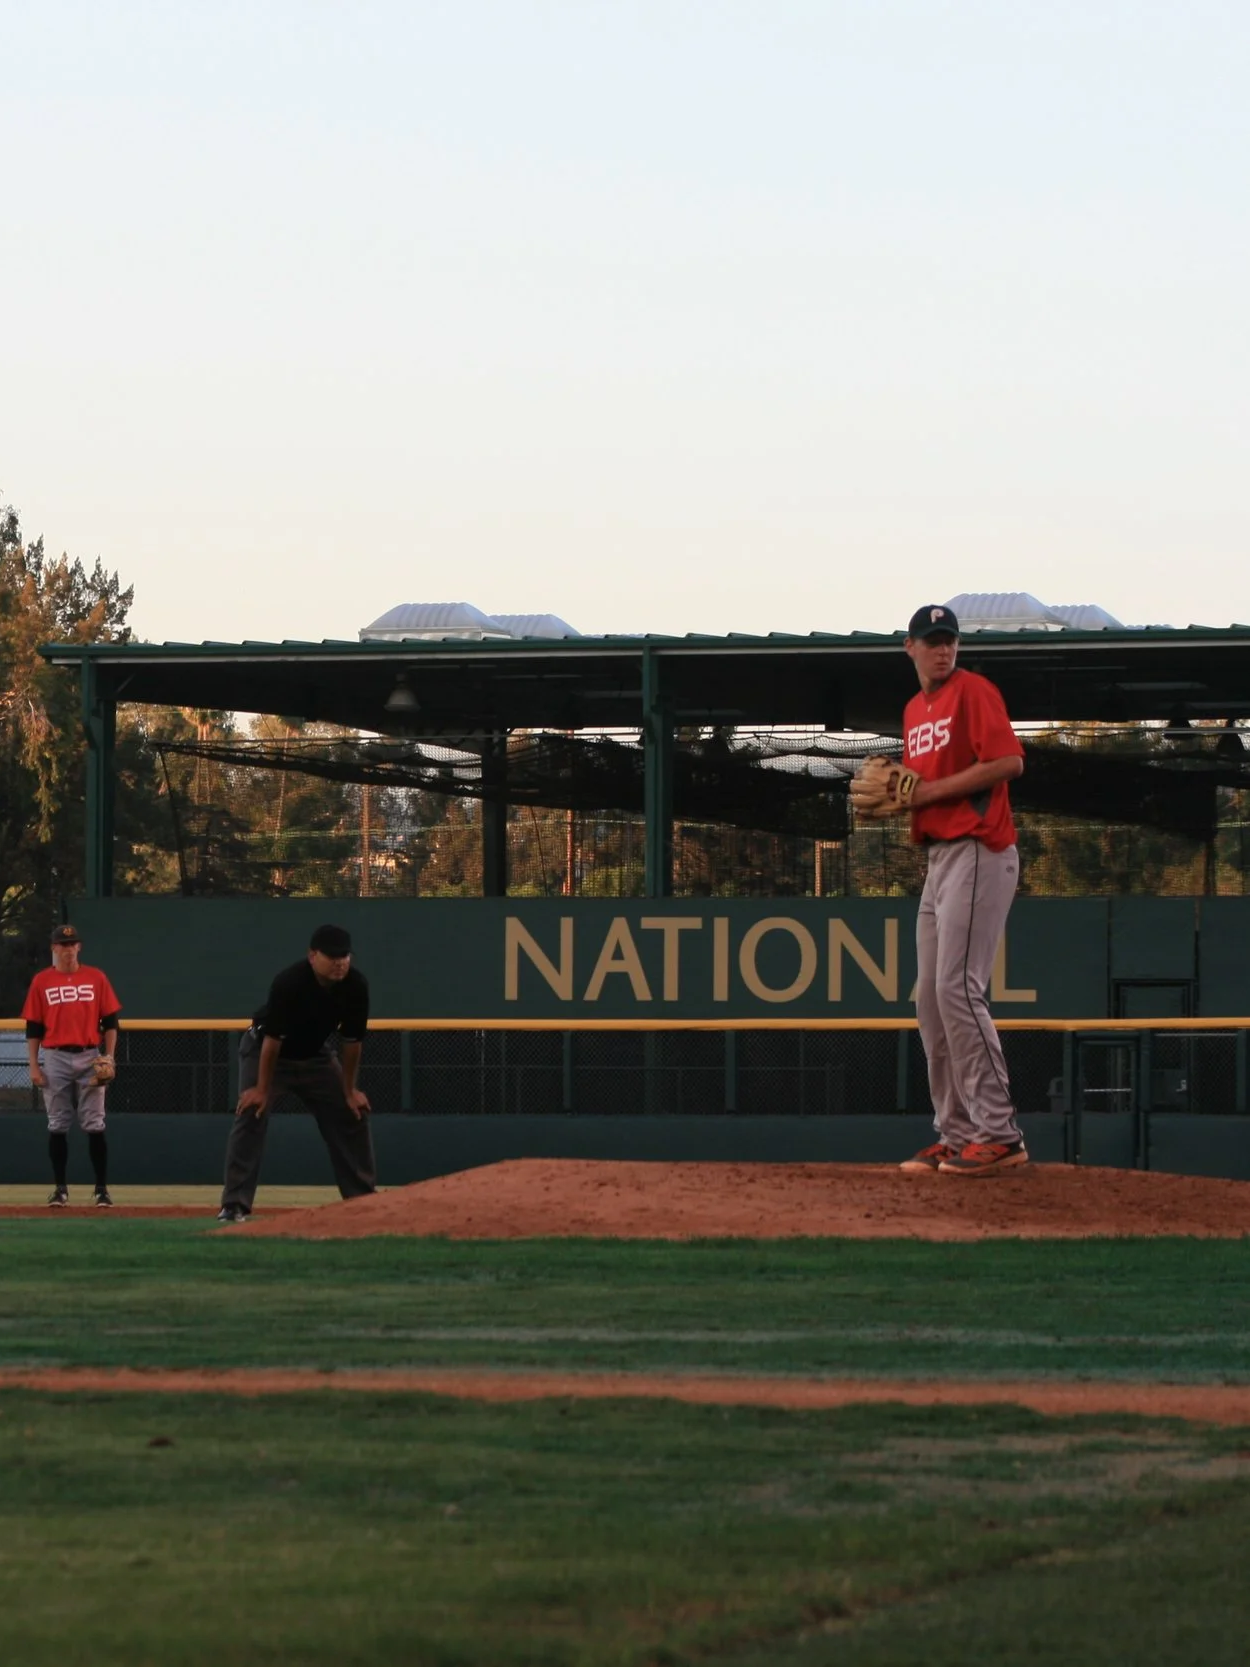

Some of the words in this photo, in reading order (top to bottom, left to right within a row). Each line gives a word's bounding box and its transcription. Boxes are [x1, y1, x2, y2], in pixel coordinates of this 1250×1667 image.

[930, 608, 944, 623] P
[908, 717, 952, 760] EBS
[504, 916, 1037, 1002] NATIONL
[45, 984, 95, 1006] EBS
